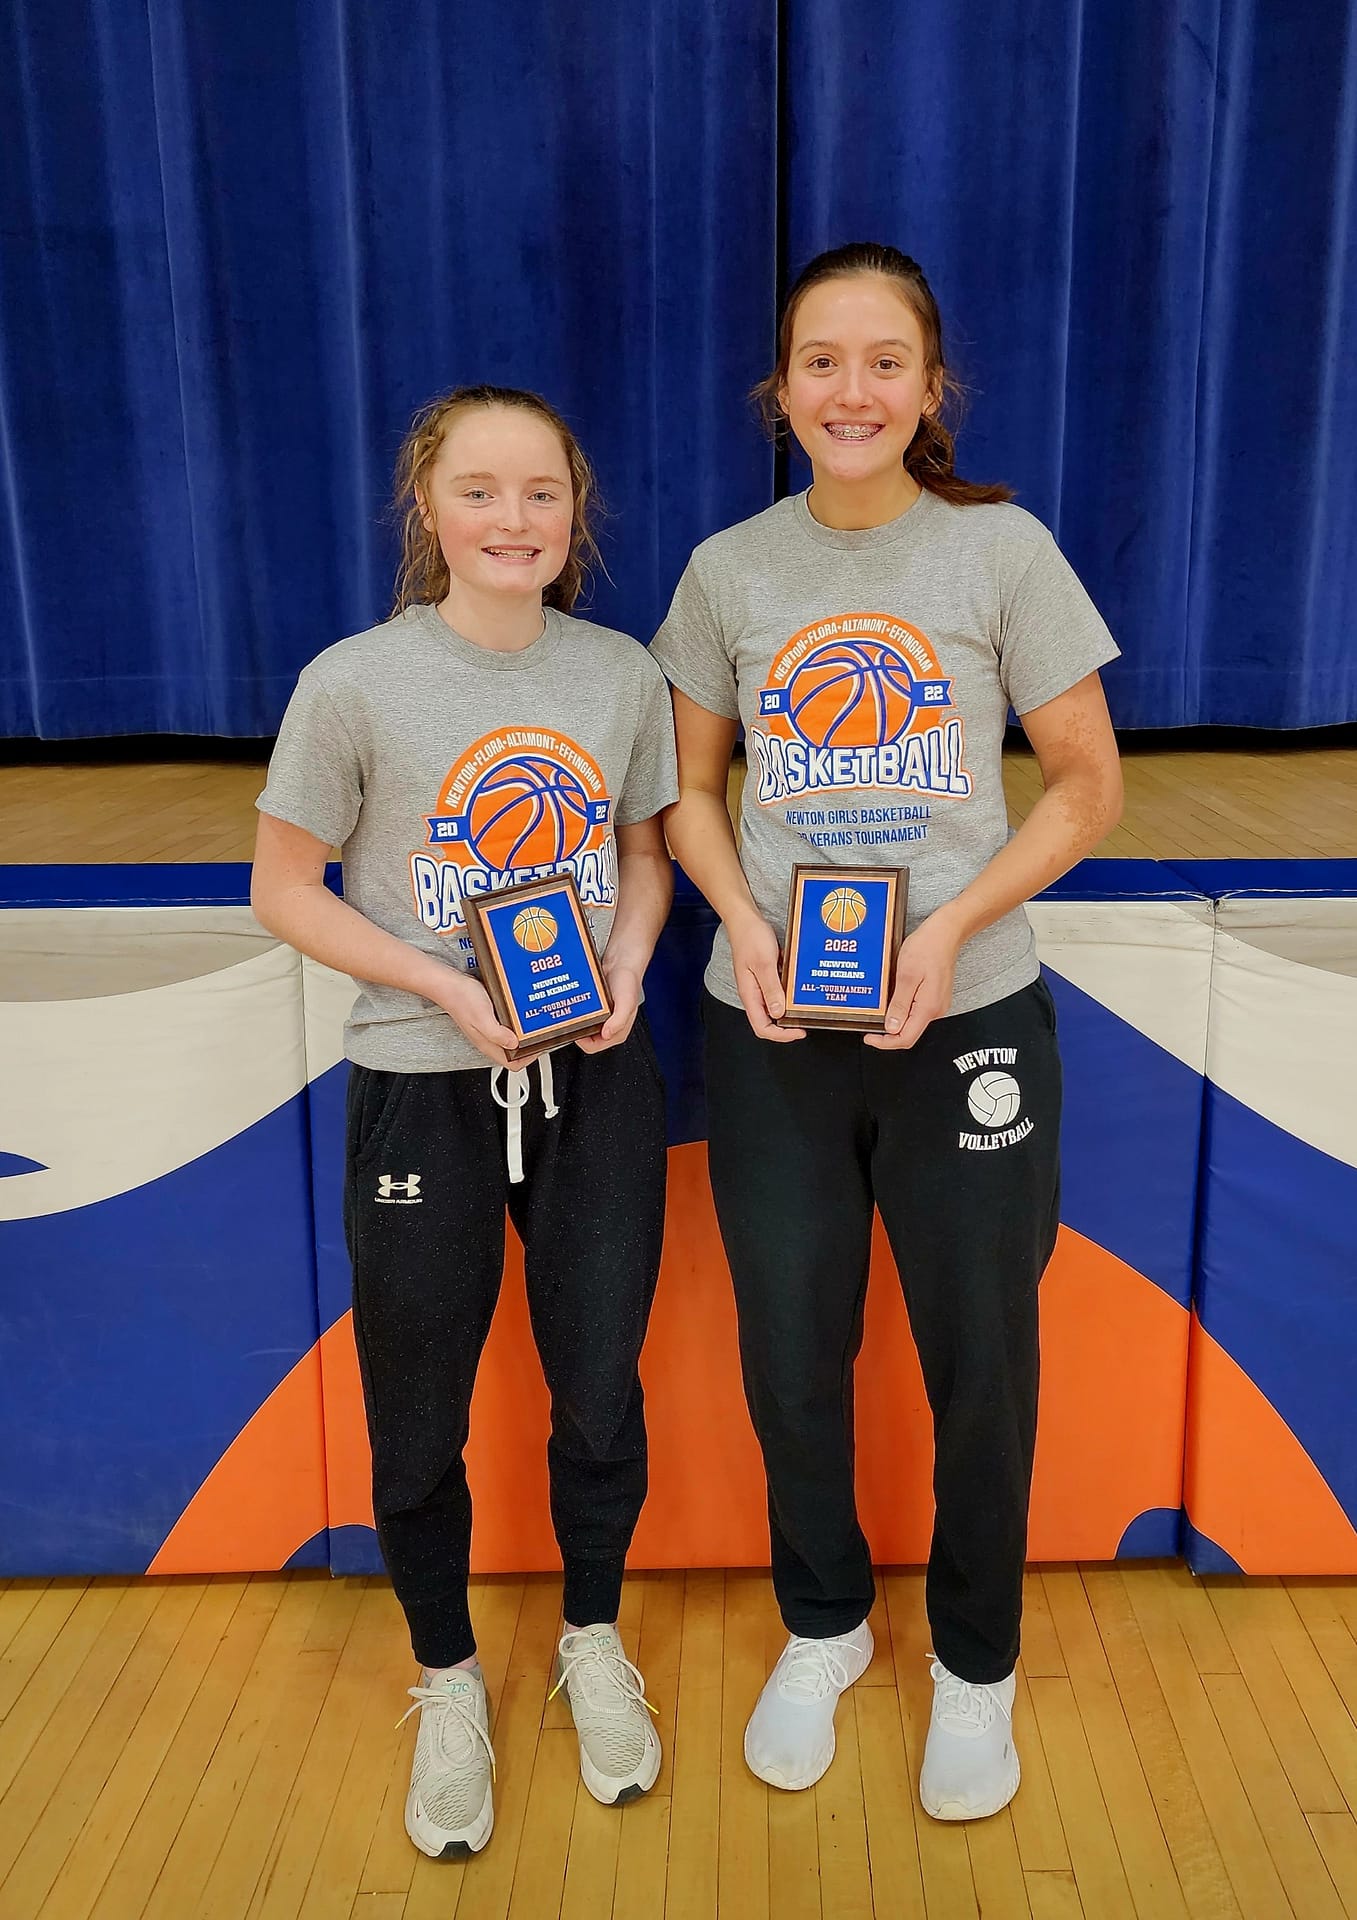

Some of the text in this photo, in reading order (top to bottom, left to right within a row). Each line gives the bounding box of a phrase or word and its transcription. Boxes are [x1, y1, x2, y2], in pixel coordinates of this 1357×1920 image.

[924, 685, 944, 701] 22
[764, 694, 780, 710] 20
[752, 721, 970, 802] BASKETBALL
[595, 805, 607, 820] 22
[786, 806, 932, 825] NEWTON GIRLS BASKETBALL
[436, 821, 458, 837] 20
[810, 831, 853, 847] KERANS
[855, 825, 928, 845] TOURNAMENT
[824, 939, 857, 953] 2022
[530, 954, 563, 974] 2022
[819, 960, 859, 969] NEWTON
[811, 969, 829, 977] BOB
[532, 973, 570, 990] NEWTON
[801, 983, 874, 994] ALL-TOURNAMENT
[528, 991, 547, 1002] BOB
[825, 993, 847, 1001] TEAM
[525, 992, 591, 1019] ALL-TOURNAMENT
[550, 1006, 572, 1019] TEAM
[953, 1047, 1018, 1074] NEWTON
[958, 1116, 1035, 1151] VOLLEYBALL
